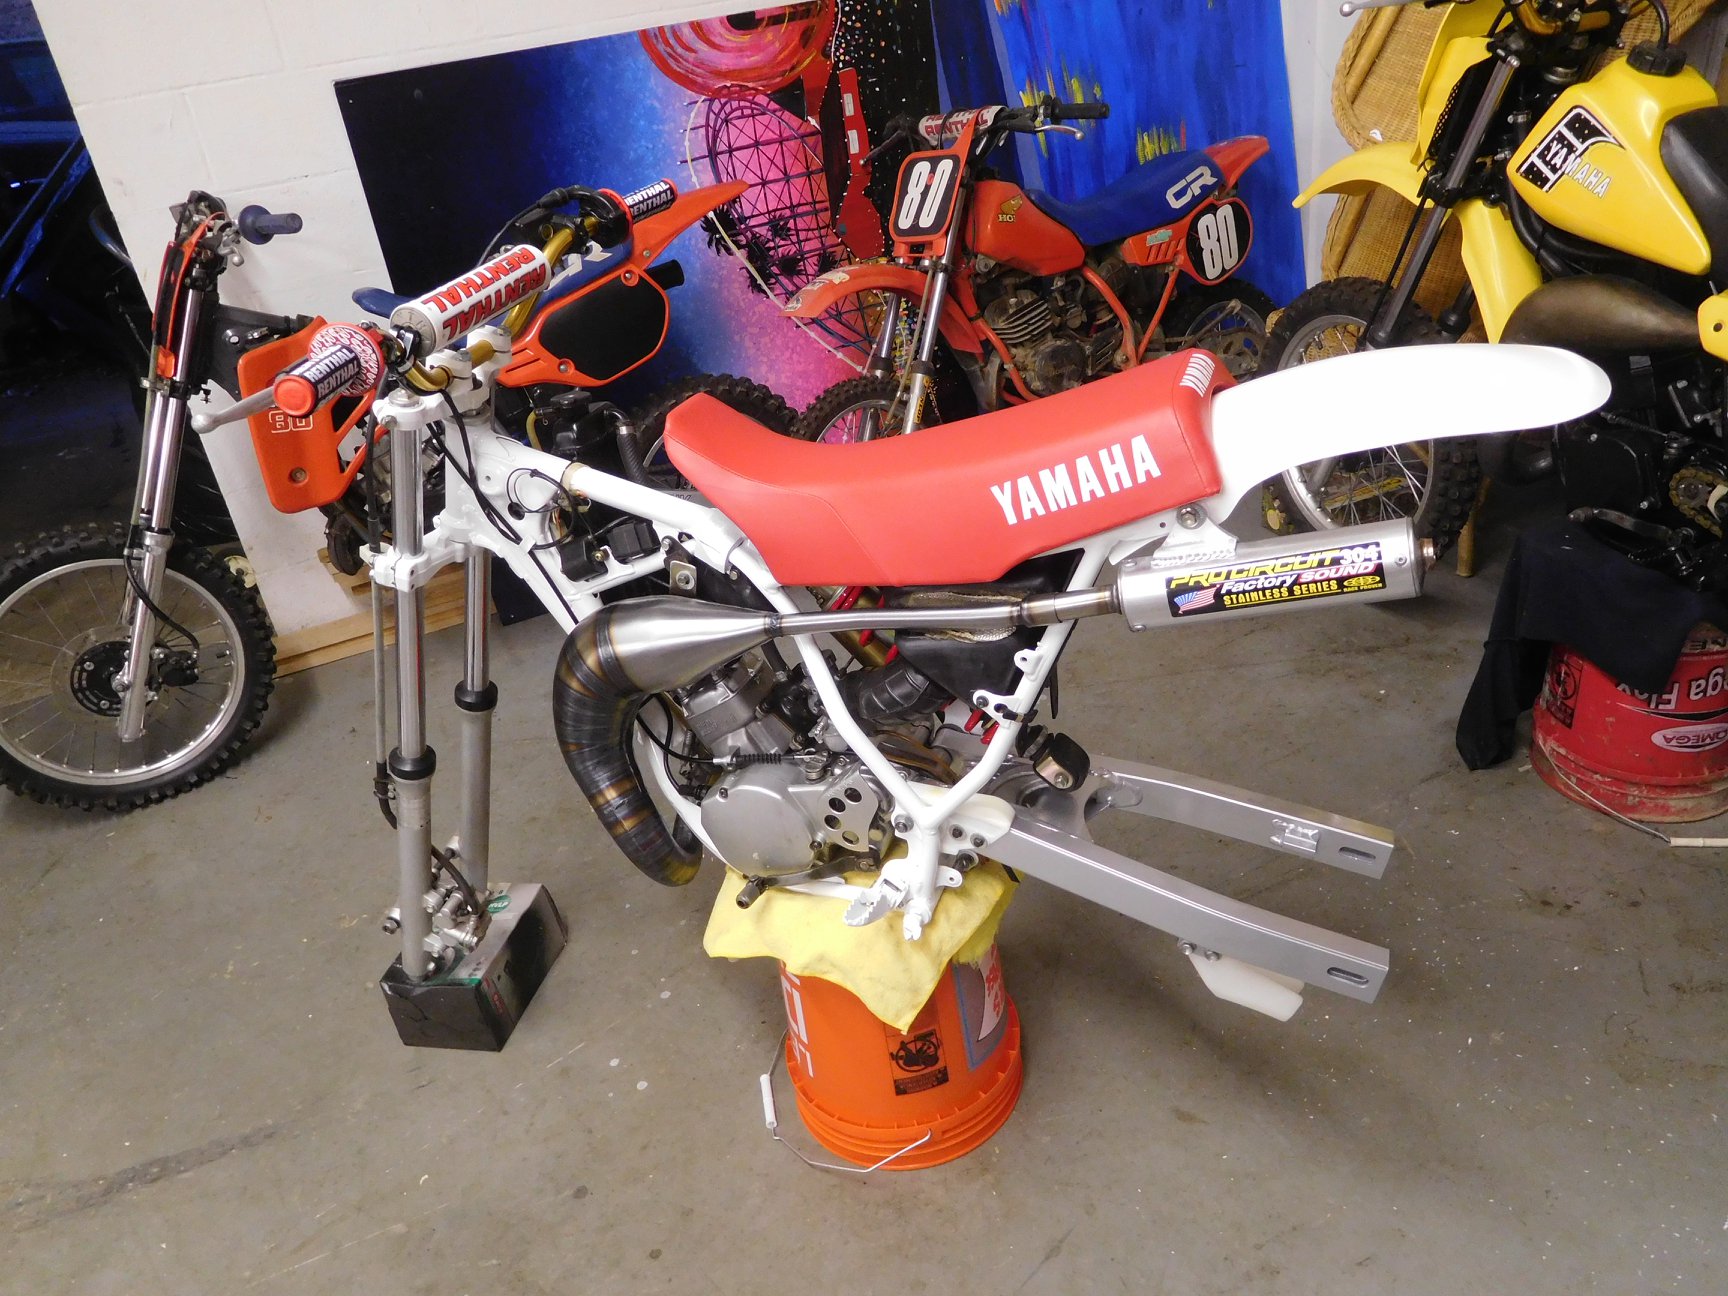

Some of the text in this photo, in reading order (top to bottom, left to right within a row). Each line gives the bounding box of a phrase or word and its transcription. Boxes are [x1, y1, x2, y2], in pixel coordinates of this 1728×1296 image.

[898, 158, 954, 230] 80
[1166, 165, 1218, 209] CR
[1546, 141, 1613, 199] YAMAHA
[1197, 204, 1239, 280] 80
[421, 247, 536, 313] RENTHAL
[443, 264, 547, 340] RENTHAL
[303, 348, 356, 383] RENTHAL
[317, 361, 360, 397] RENTHAL
[990, 434, 1161, 525] YAMAHA
[1220, 562, 1376, 594] Factory SOUND
[1223, 579, 1338, 605] STAINLESS SERIES
